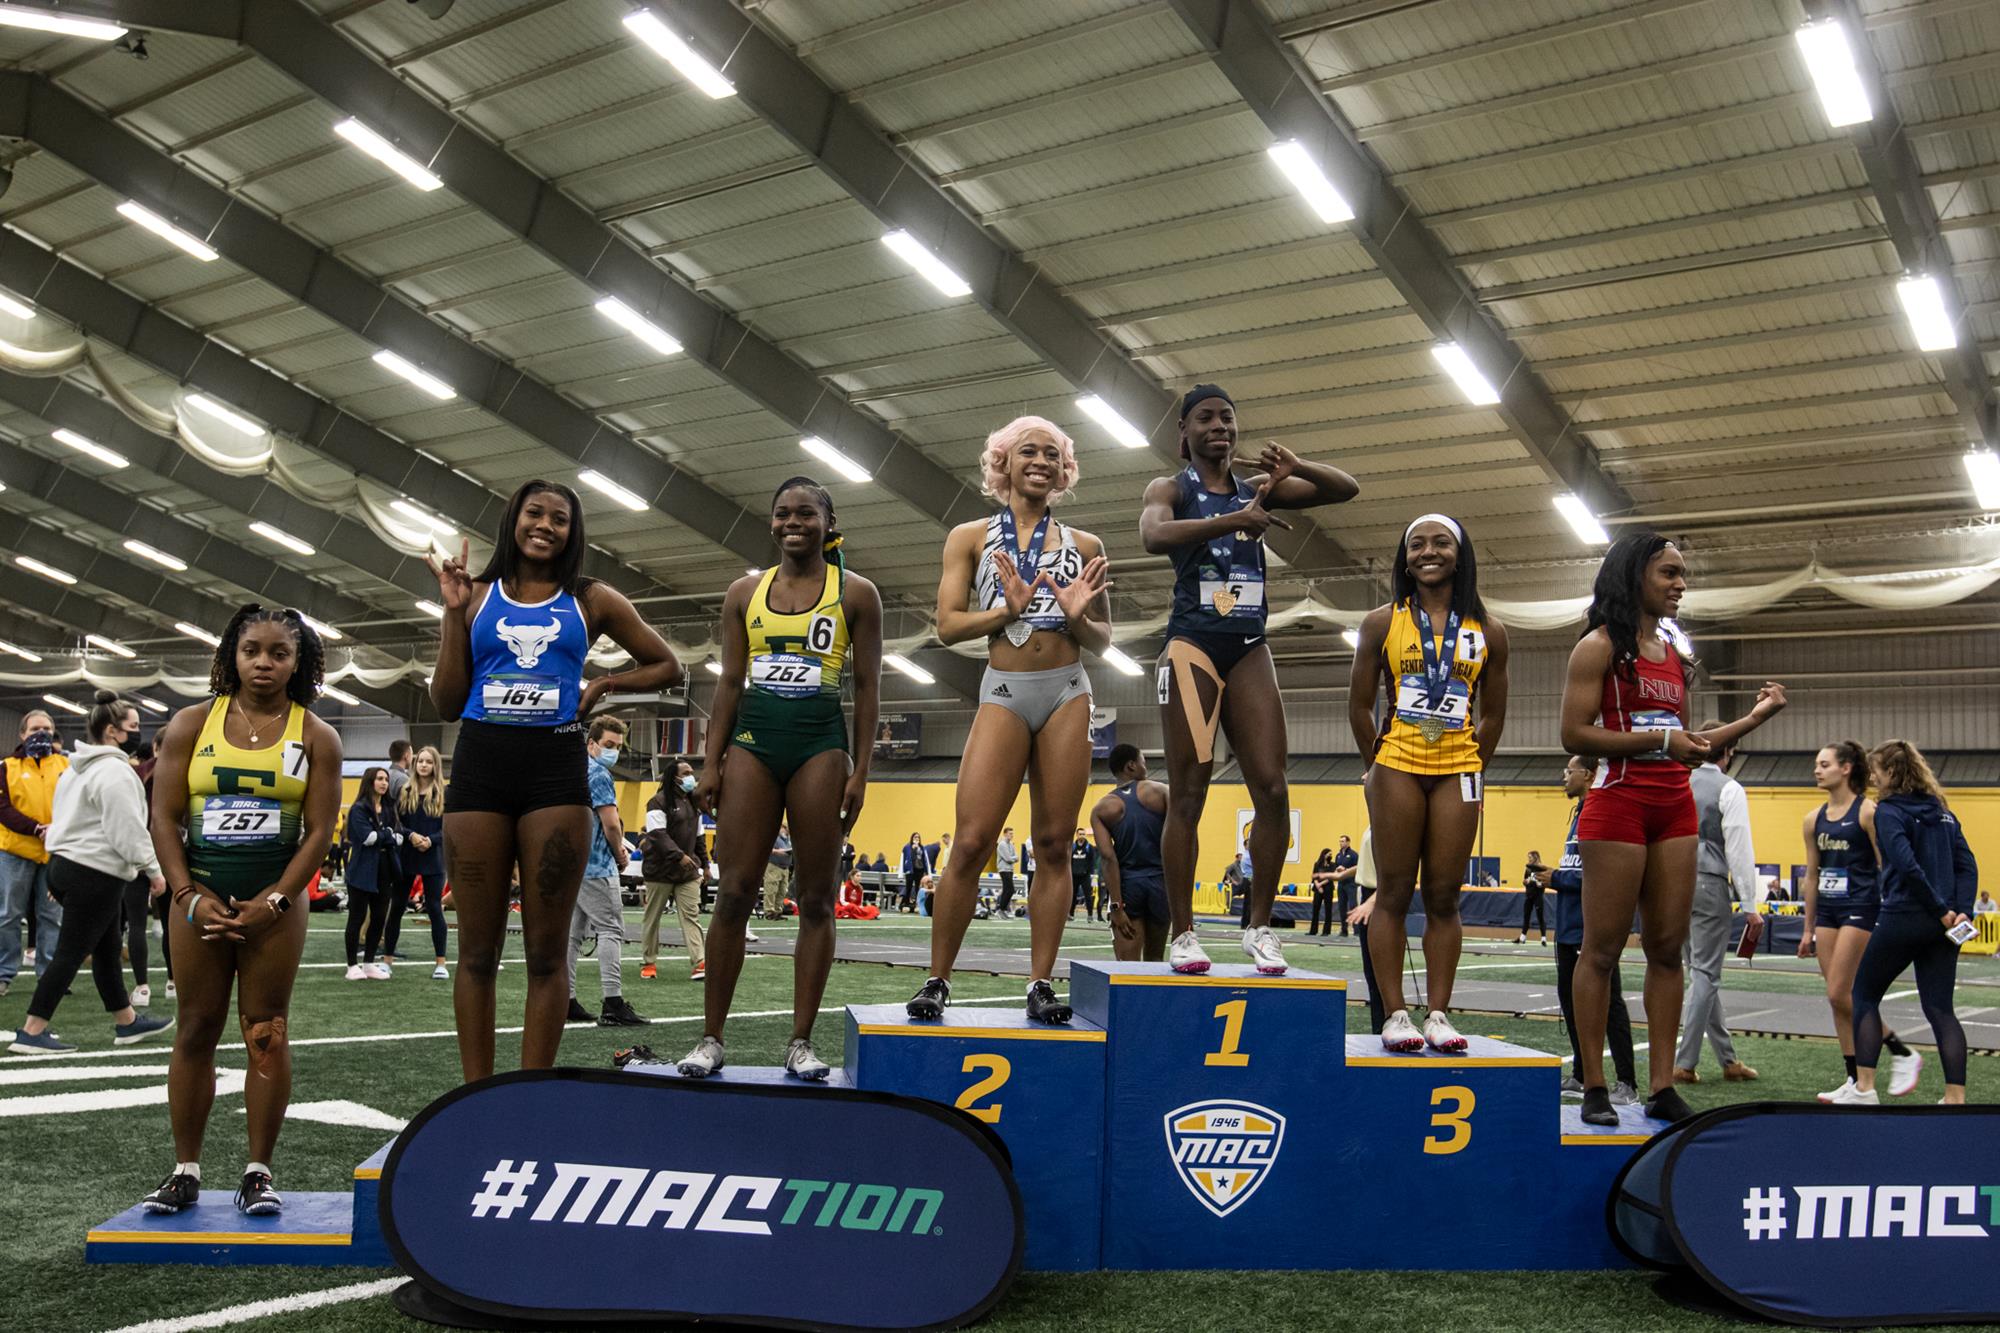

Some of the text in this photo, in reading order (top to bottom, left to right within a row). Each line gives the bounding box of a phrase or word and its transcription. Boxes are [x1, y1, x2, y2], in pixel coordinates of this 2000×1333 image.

[1063, 548, 1079, 579] 5
[1022, 597, 1057, 614] 57
[812, 617, 833, 650] 6
[1462, 632, 1476, 660] 1
[765, 666, 810, 682] 262
[1400, 659, 1425, 674] CENTR
[503, 689, 543, 705] 164
[1159, 670, 1167, 702] 4
[1639, 676, 1680, 704] NIU
[1411, 692, 1457, 713] 25
[291, 742, 306, 776] 7
[1464, 772, 1477, 799] 1
[218, 813, 269, 831] 257
[1824, 880, 1838, 888] 27
[1204, 999, 1250, 1067] 1
[954, 1053, 1011, 1123] 2
[1210, 1117, 1240, 1128] 1946
[1423, 1085, 1476, 1155] 3
[1178, 1137, 1272, 1164] MAC
